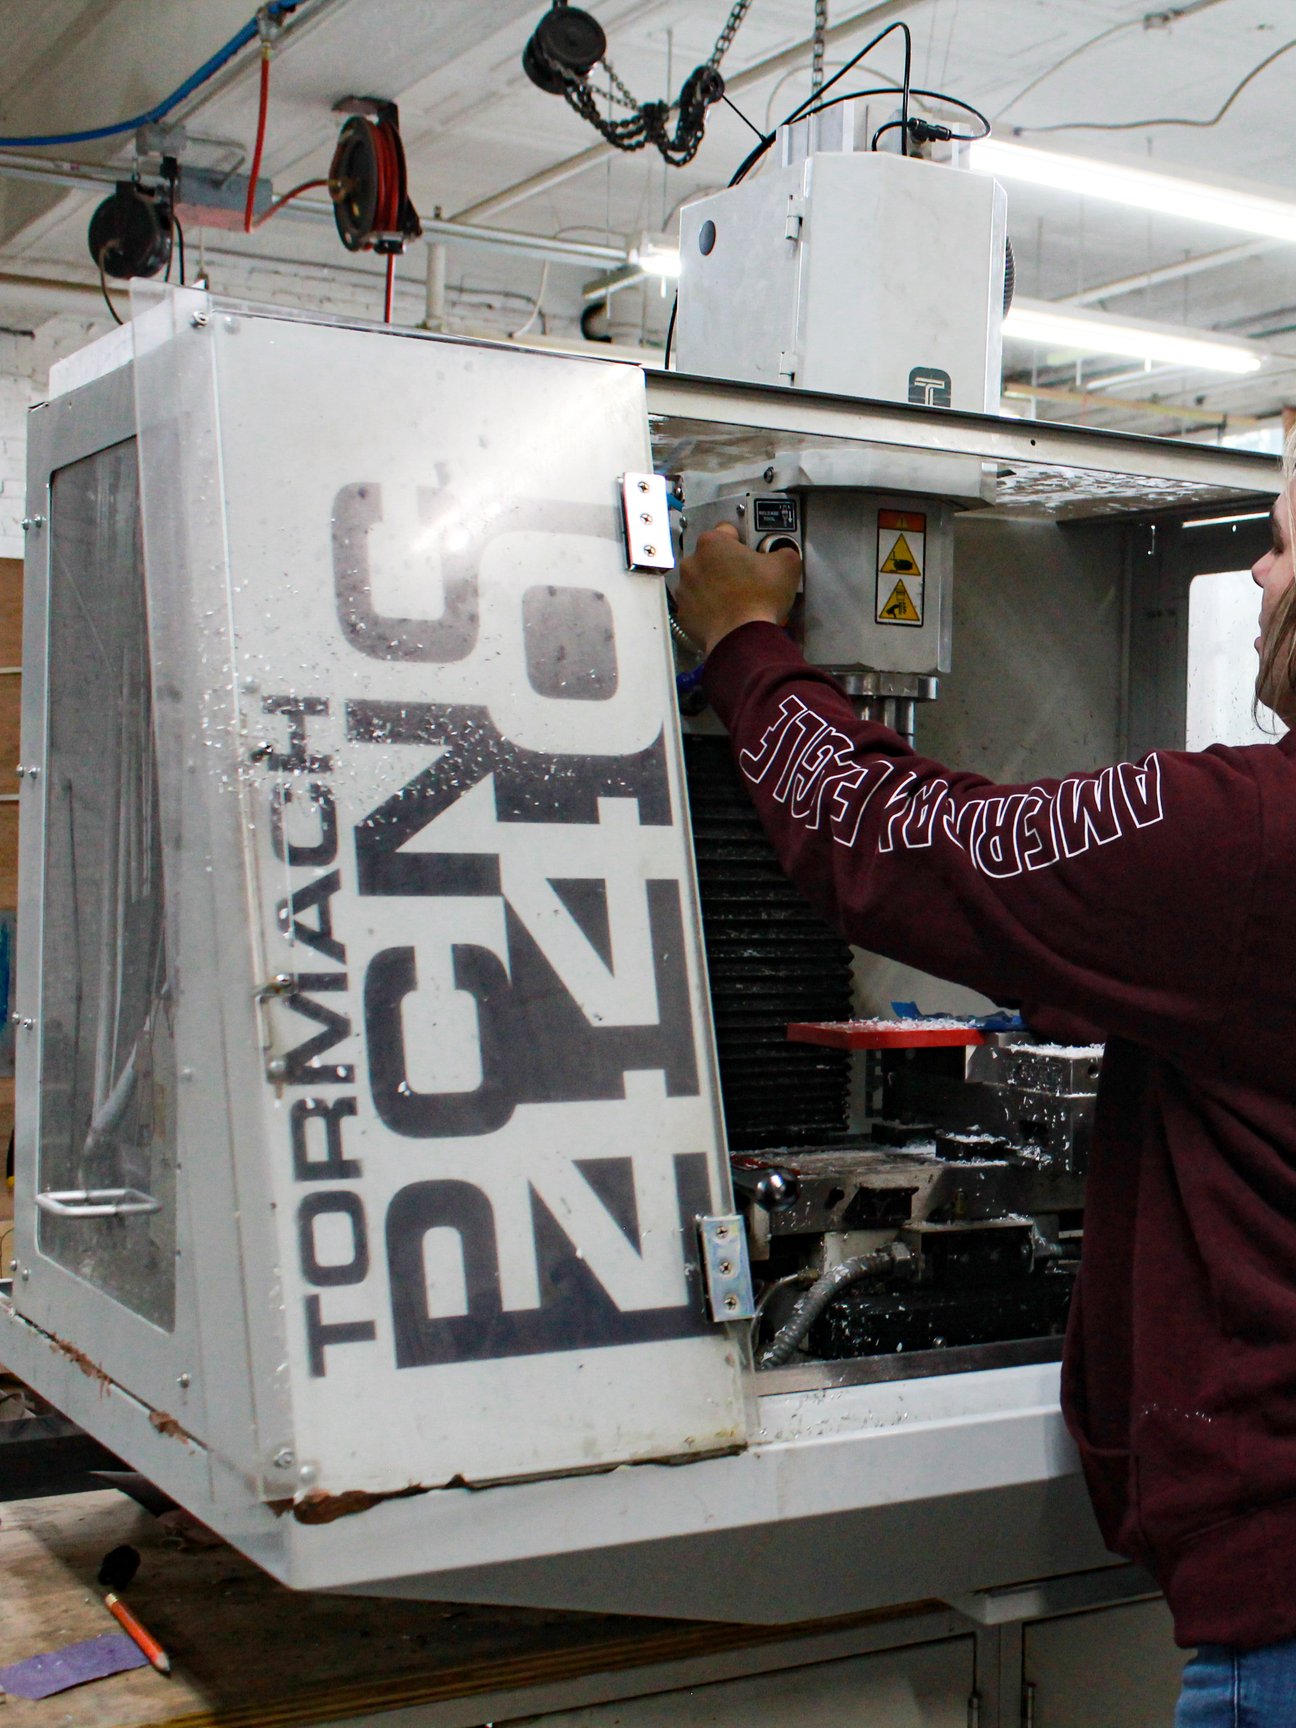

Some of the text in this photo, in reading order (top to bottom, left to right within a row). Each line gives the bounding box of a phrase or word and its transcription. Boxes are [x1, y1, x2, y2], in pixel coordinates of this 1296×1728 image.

[261, 695, 377, 1377] TORMACH
[332, 482, 519, 1369] PCNC
[478, 530, 708, 1310] 440
